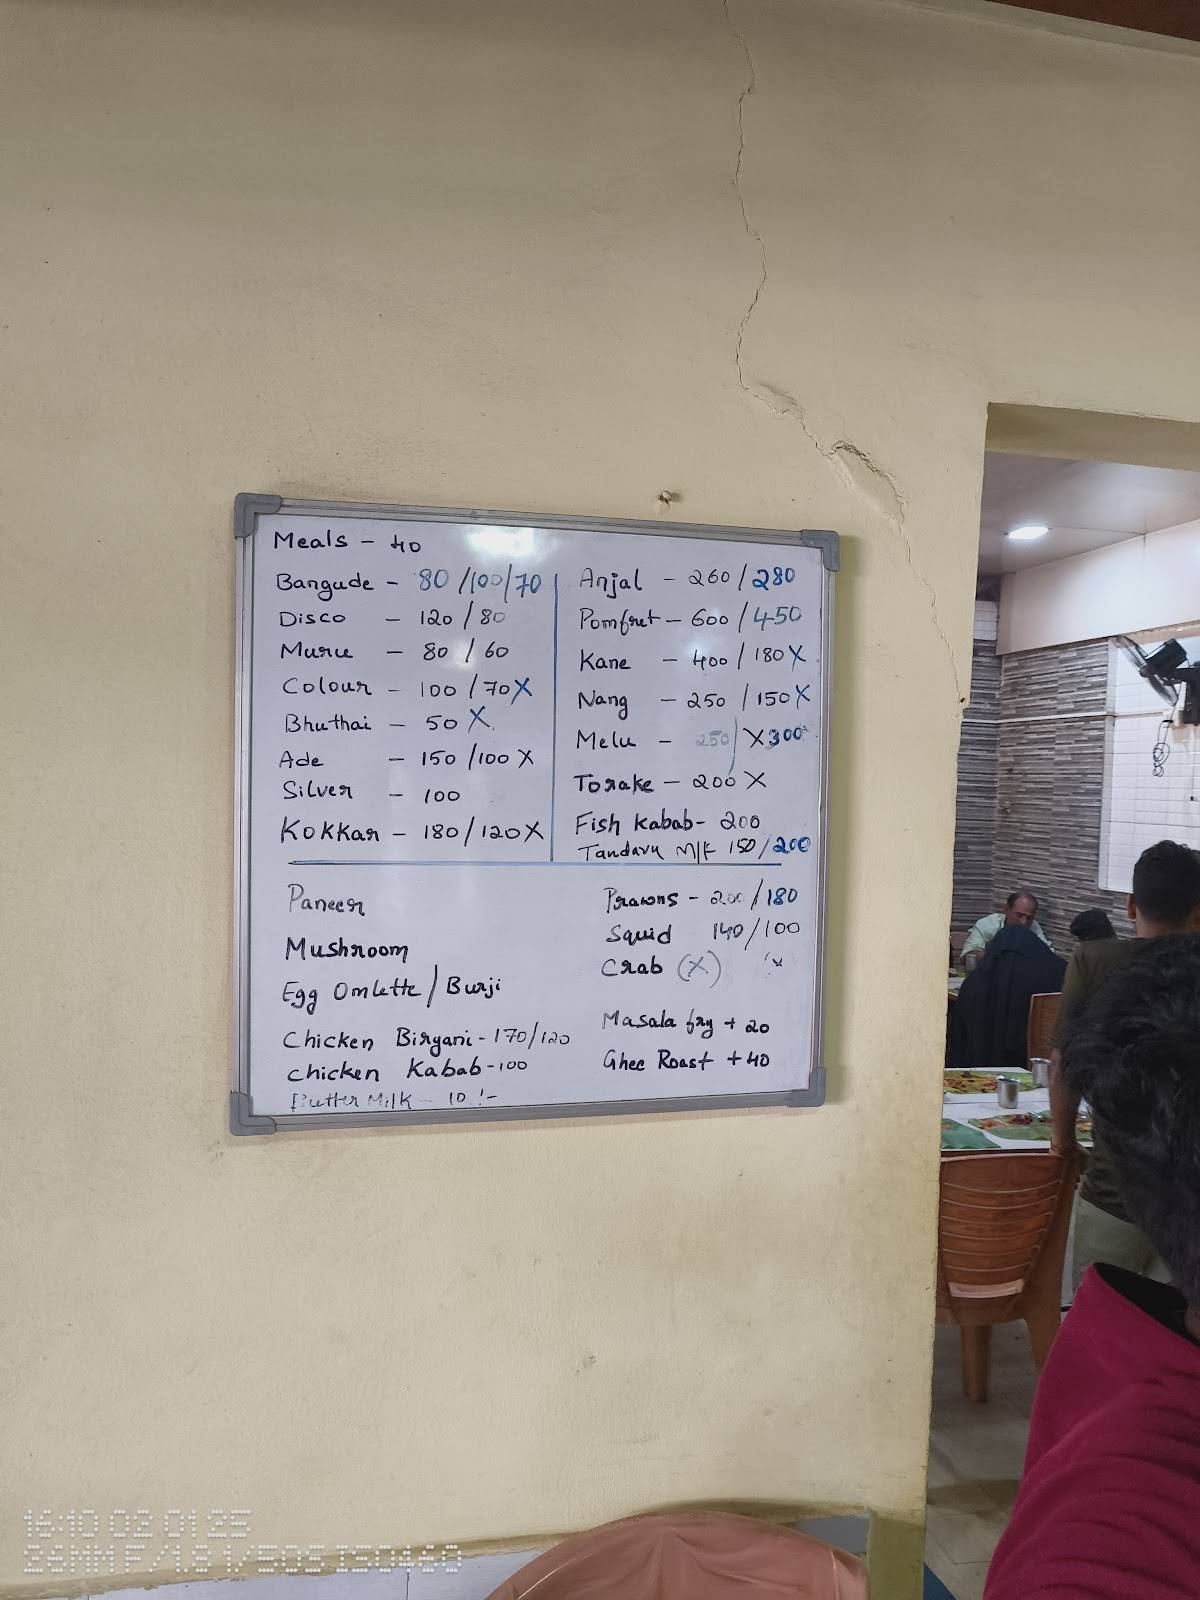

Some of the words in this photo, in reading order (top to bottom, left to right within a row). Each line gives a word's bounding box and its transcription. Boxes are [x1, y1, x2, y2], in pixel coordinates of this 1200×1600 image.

[274, 530, 348, 549] Meals
[390, 535, 422, 553] 40
[579, 568, 642, 599] Anjal
[279, 611, 347, 627] Disco
[579, 607, 662, 636] Pomfret
[579, 649, 632, 672] Kane
[282, 676, 372, 695] Colour
[578, 691, 629, 720] Nang
[284, 713, 372, 733] Bhuthai
[426, 715, 458, 731] 50
[576, 729, 637, 750] Melu
[279, 750, 325, 769] Ade
[283, 781, 354, 800] Silver
[424, 788, 461, 804] 100
[573, 773, 655, 795] Torake
[692, 773, 736, 790] 200
[576, 810, 621, 835] Fish
[720, 810, 761, 830] 200
[603, 887, 679, 914] Prawns
[605, 924, 672, 946] Squid
[285, 937, 409, 964] Mushroom
[601, 955, 664, 977] Crab
[282, 981, 318, 1015] Egg
[446, 976, 501, 998] Burji
[602, 1009, 678, 1029] Masala
[686, 1008, 714, 1040] fry
[745, 1019, 771, 1034] 20
[283, 1029, 375, 1052] Chicken
[602, 1049, 646, 1071] Ghee
[657, 1049, 715, 1071] Roast
